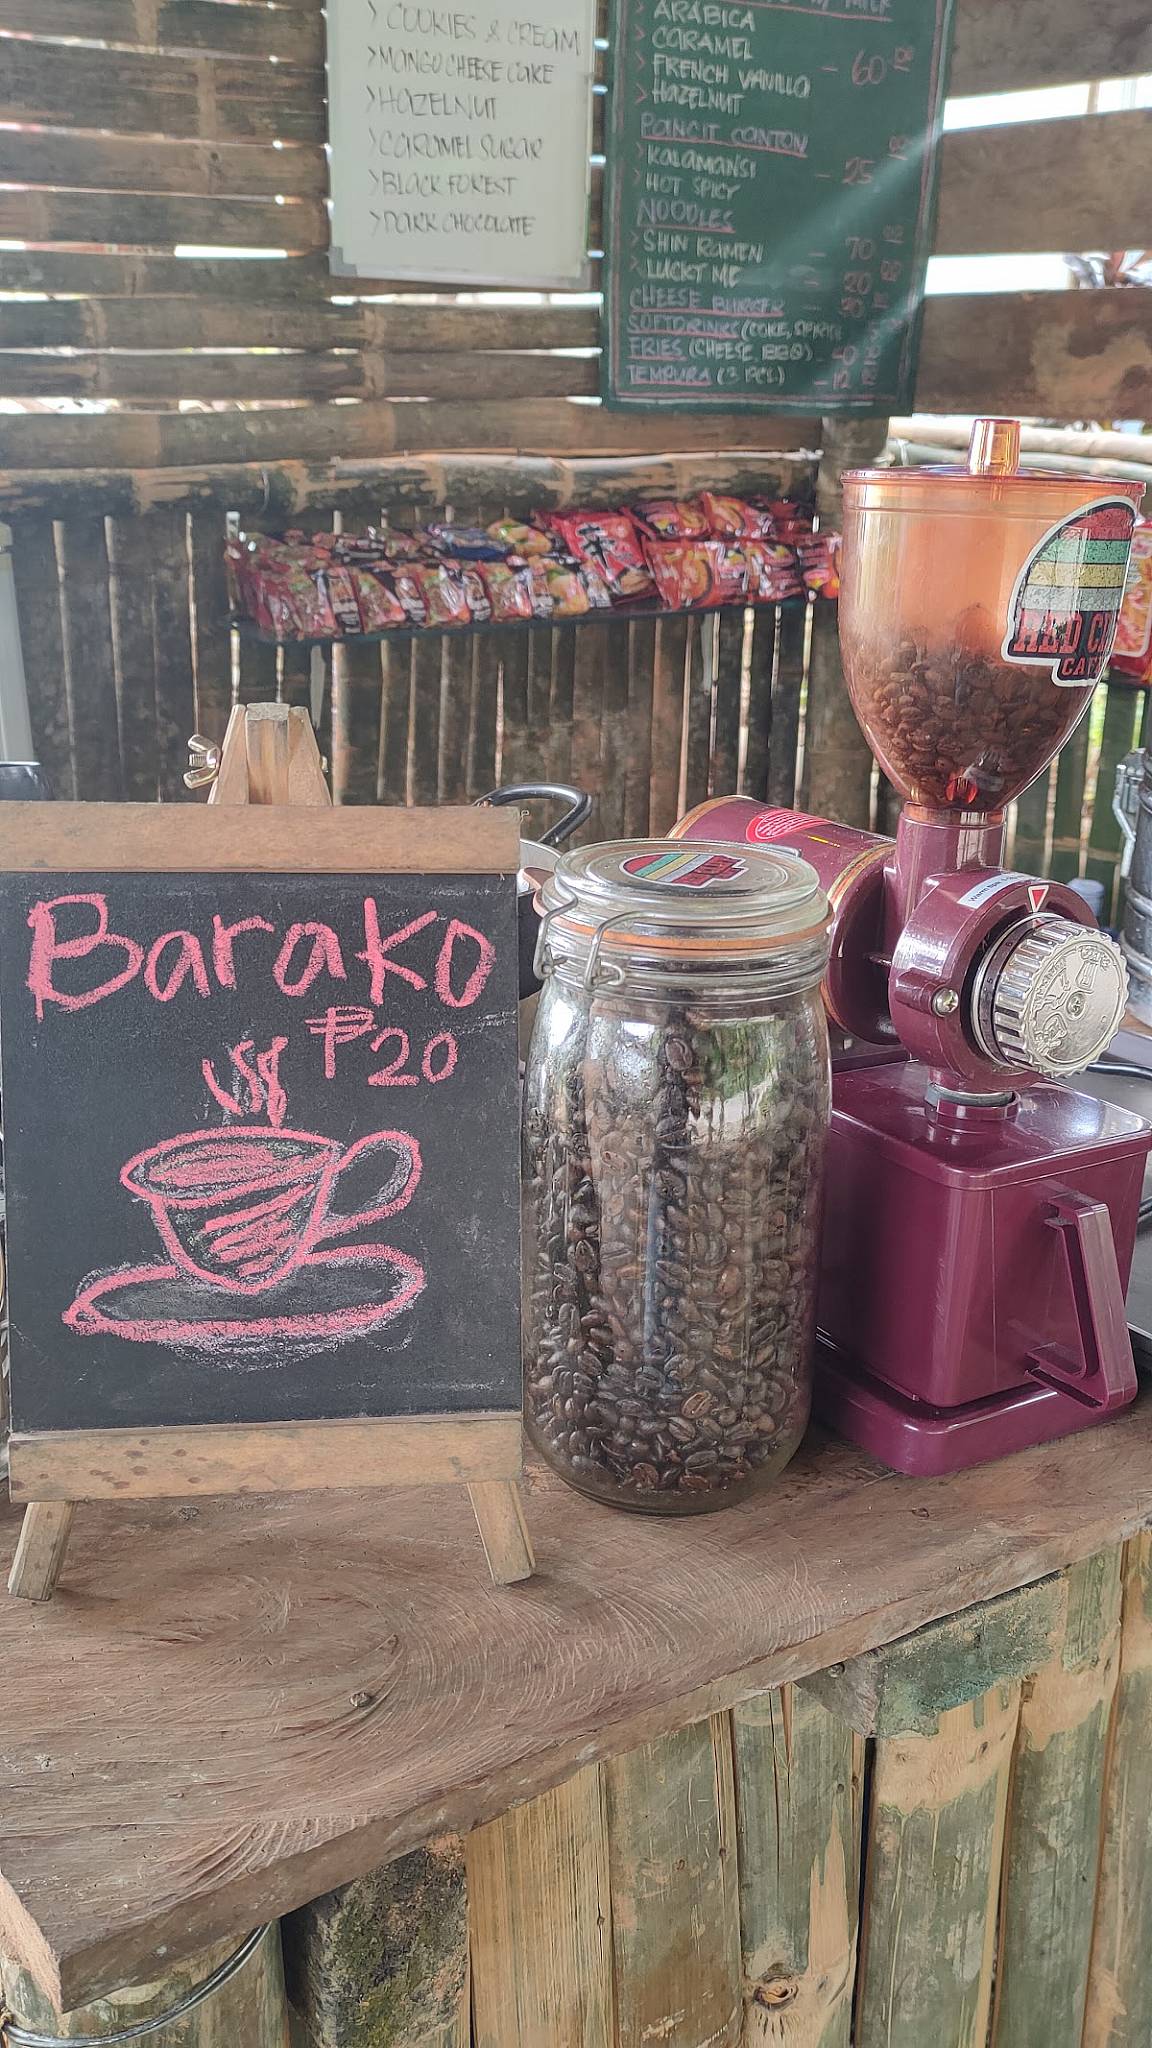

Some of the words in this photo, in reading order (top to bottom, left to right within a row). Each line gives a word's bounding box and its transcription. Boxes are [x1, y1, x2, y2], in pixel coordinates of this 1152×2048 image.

[386, 0, 477, 40] COOKIES
[507, 20, 581, 56] CREAM
[653, 0, 756, 33] ARABICA
[653, 52, 730, 85] FRENCH
[645, 172, 683, 197] HOT
[692, 175, 742, 201] SPICY
[636, 196, 737, 230] NOODLES
[643, 228, 690, 254] SHIN
[629, 283, 701, 312] CHEESE
[629, 337, 684, 360] FRIES
[626, 363, 711, 387] TEMPURA
[26, 892, 498, 1024] Barako
